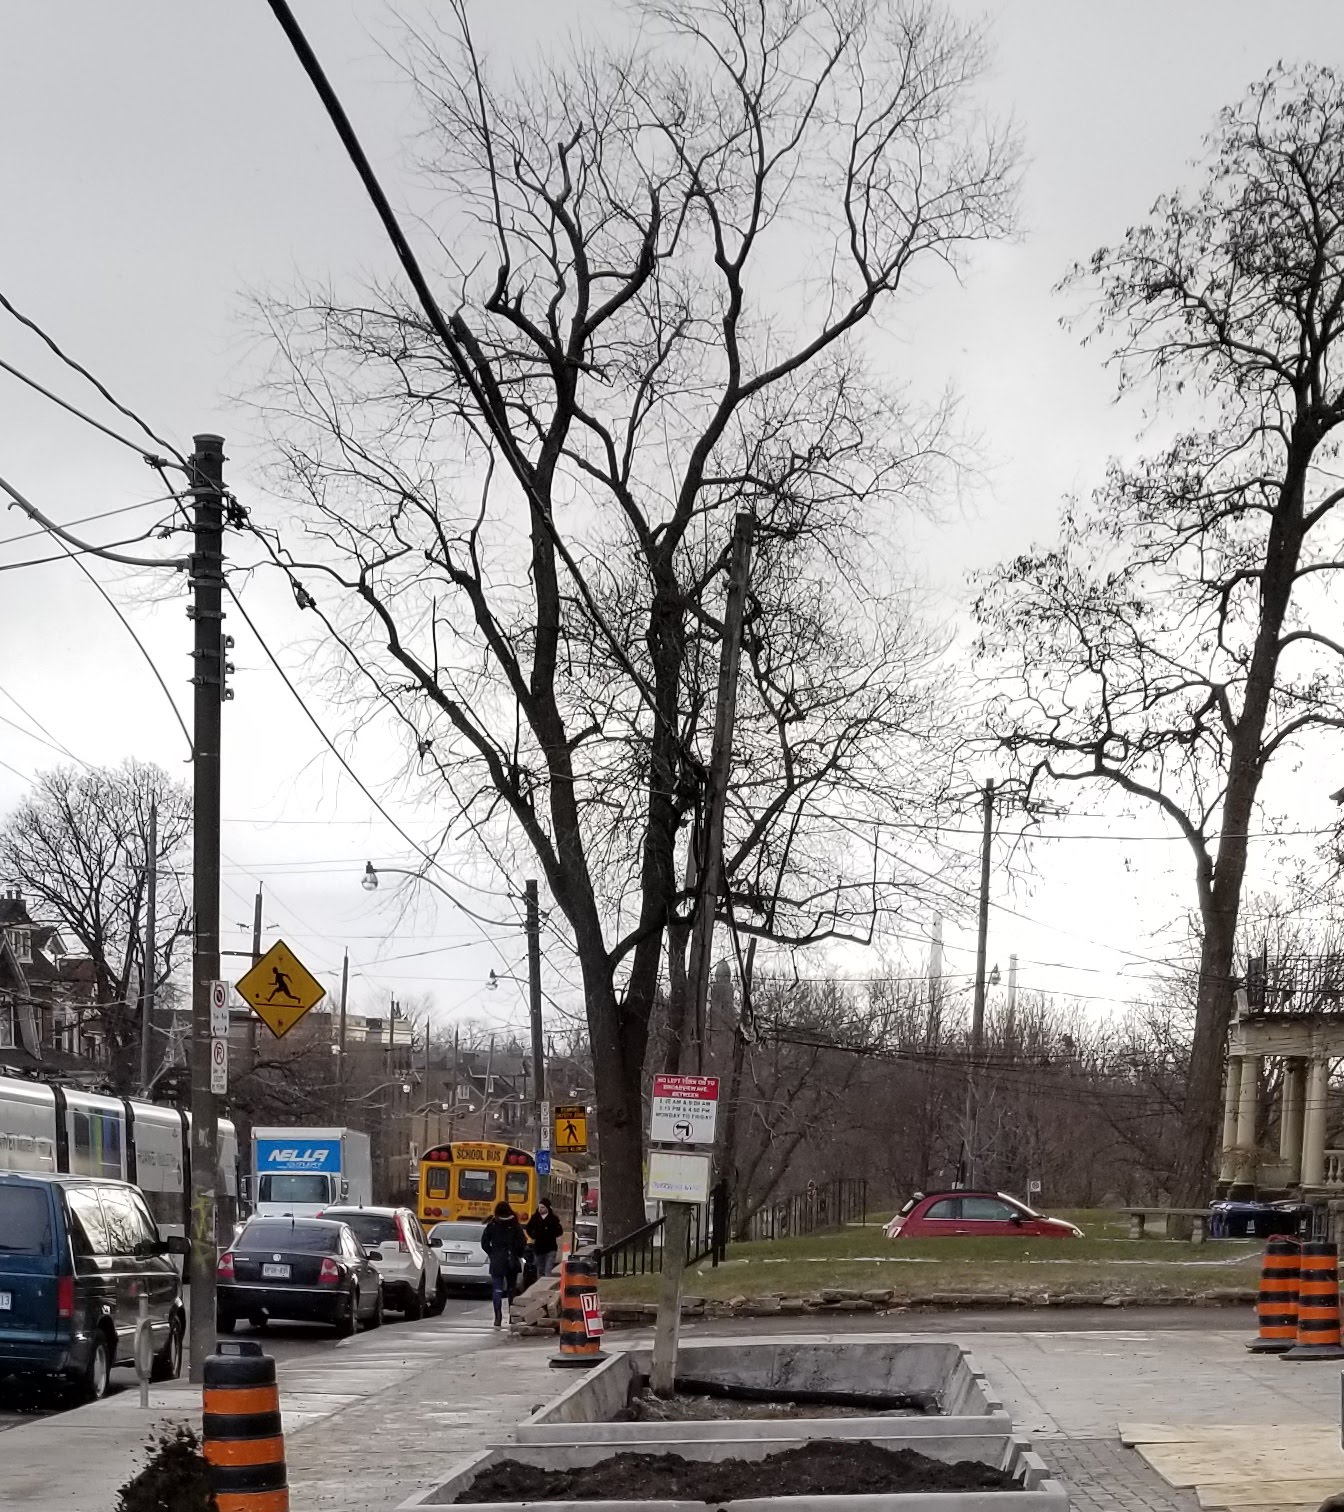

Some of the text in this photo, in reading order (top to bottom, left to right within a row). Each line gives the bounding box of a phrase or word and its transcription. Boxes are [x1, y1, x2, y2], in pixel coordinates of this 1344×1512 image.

[267, 1149, 330, 1162] NELLA
[456, 1148, 501, 1161] SCHOOL BUS
